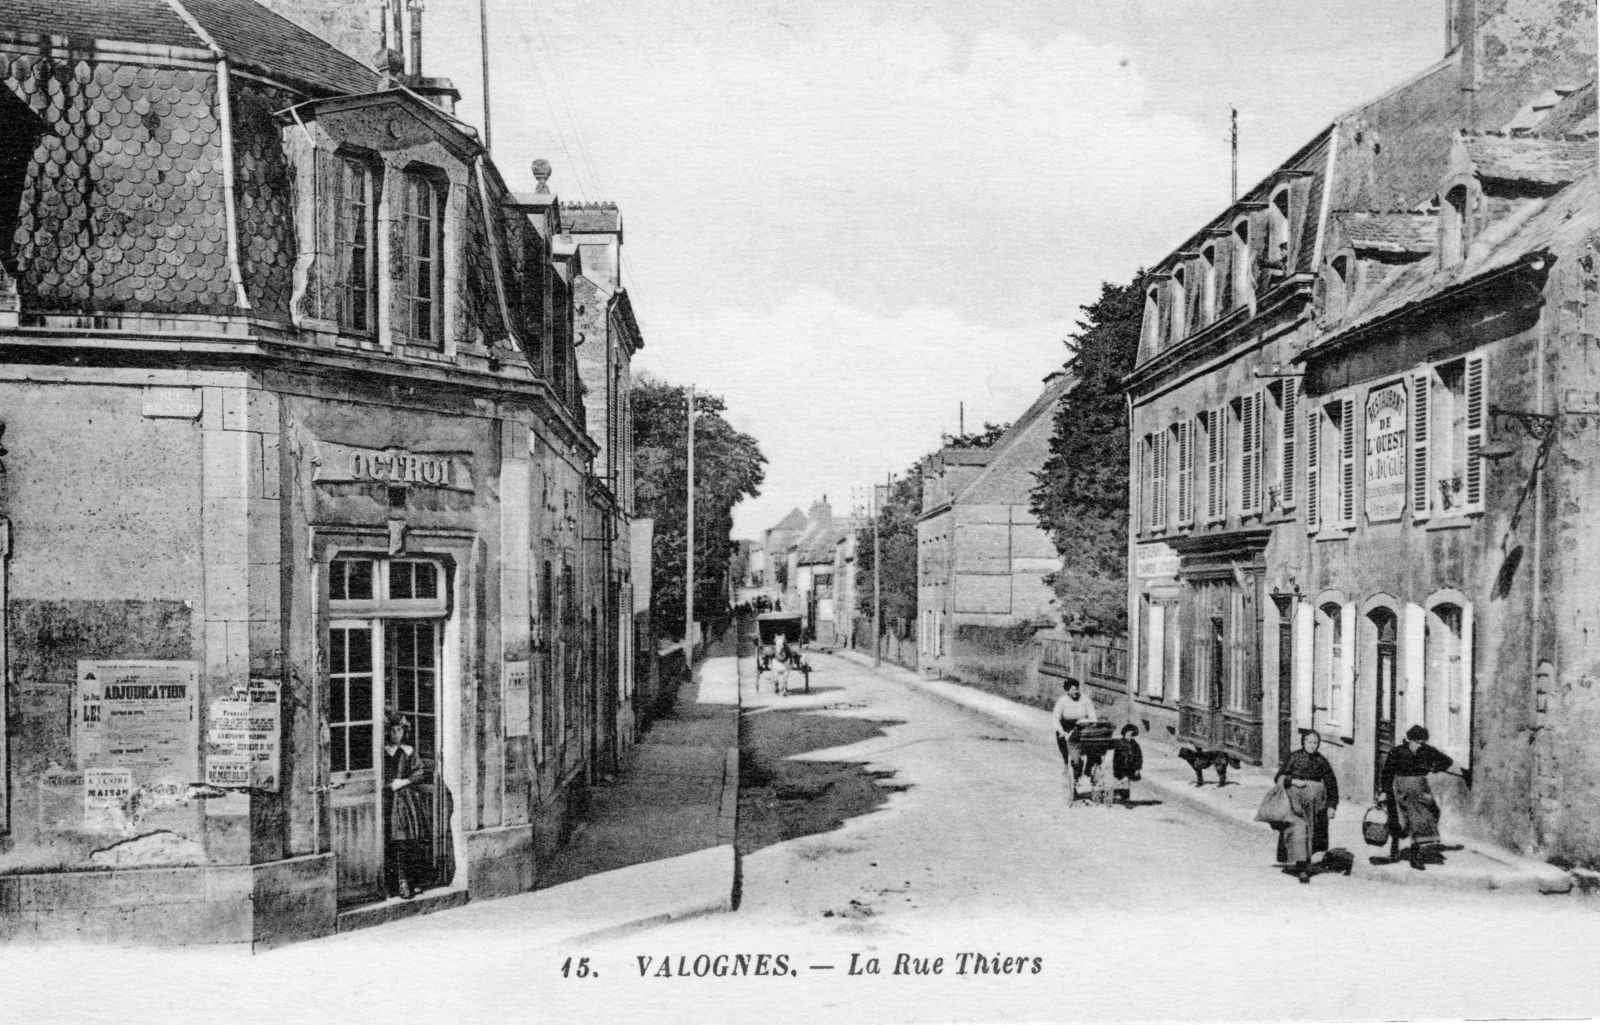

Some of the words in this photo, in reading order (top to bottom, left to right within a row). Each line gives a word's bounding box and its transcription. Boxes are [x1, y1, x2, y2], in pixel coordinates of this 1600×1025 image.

[1367, 389, 1405, 424] RESTAURANT
[1379, 416, 1391, 430] DE
[1367, 429, 1405, 456] L'OUEST
[349, 450, 451, 486] OCTROI
[104, 685, 187, 700] ADJUDICATION
[87, 789, 129, 797] MAISON
